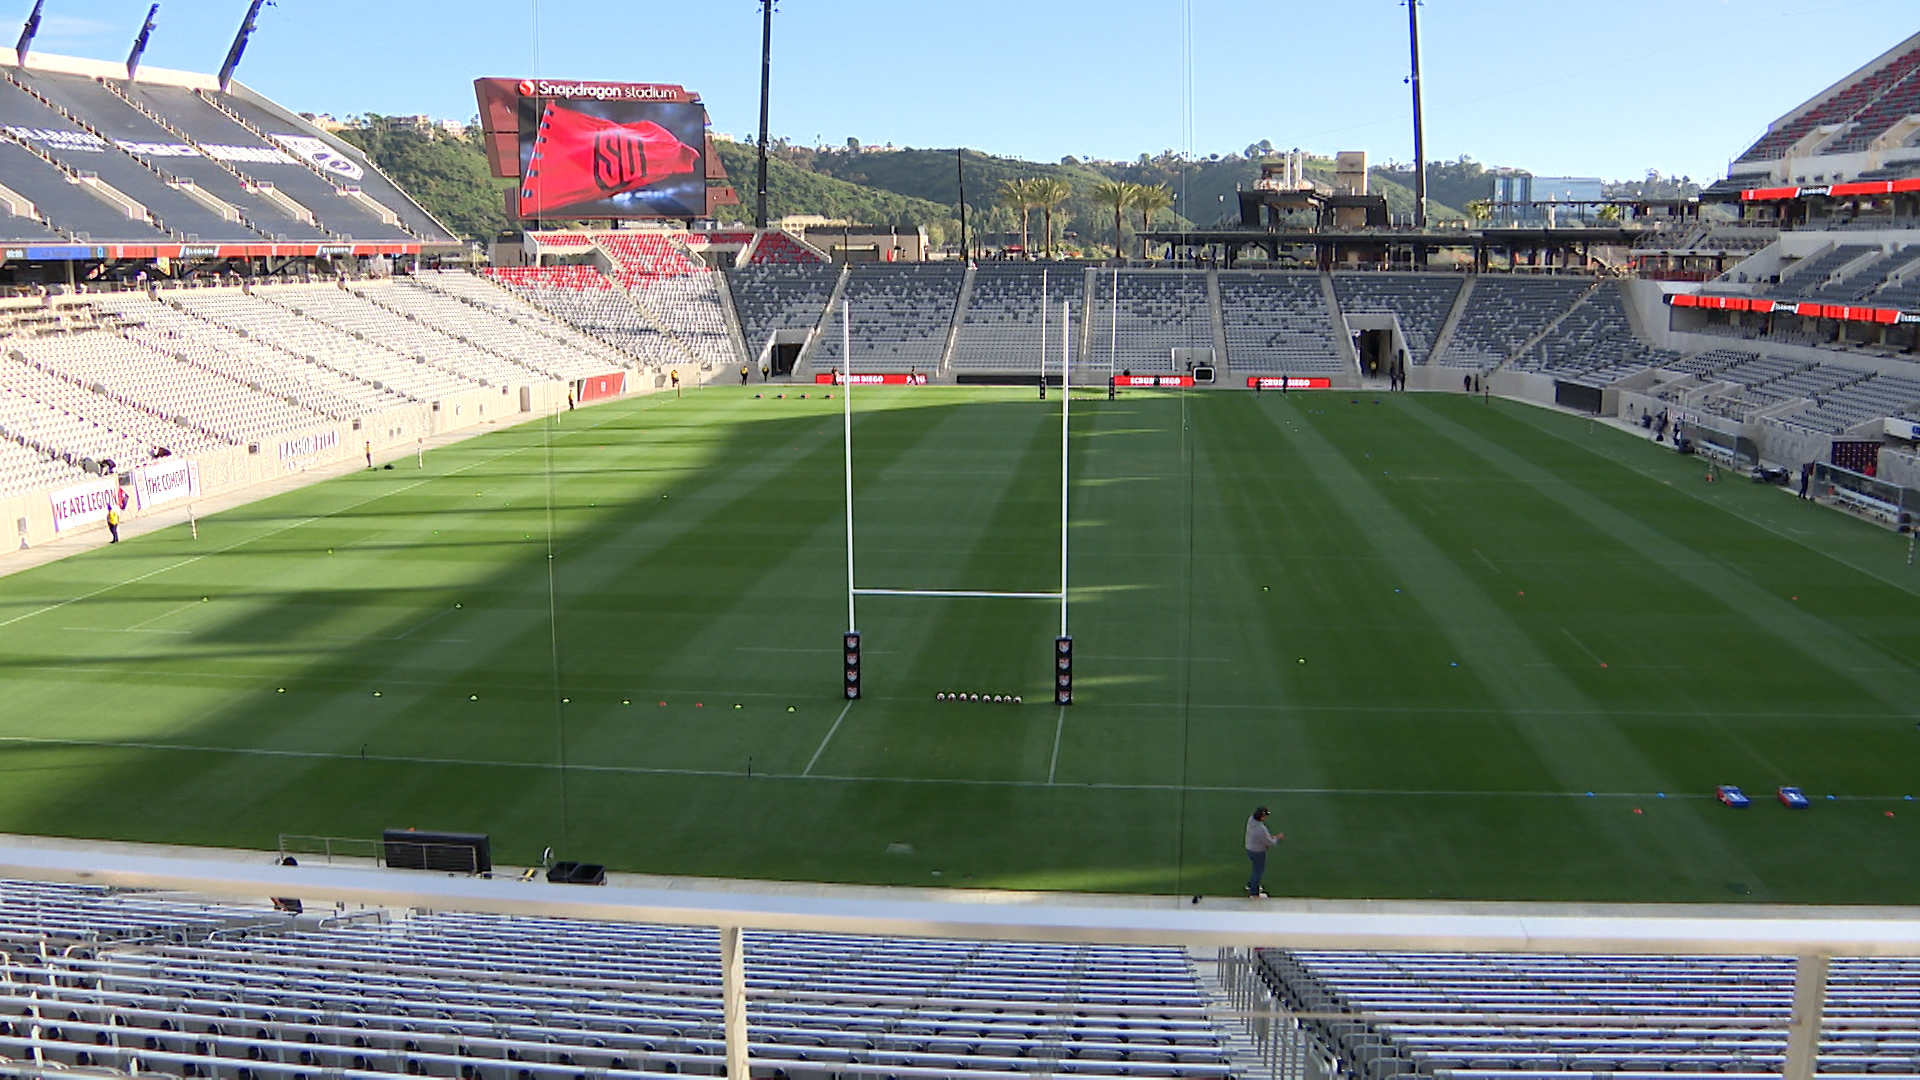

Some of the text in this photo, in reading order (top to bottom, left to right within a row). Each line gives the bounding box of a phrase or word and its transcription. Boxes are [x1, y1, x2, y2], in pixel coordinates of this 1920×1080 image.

[539, 80, 678, 100] Snapdragon stadium
[147, 469, 187, 495] THE COHORT
[69, 495, 87, 516] ARE
[87, 487, 118, 512] LEGION
